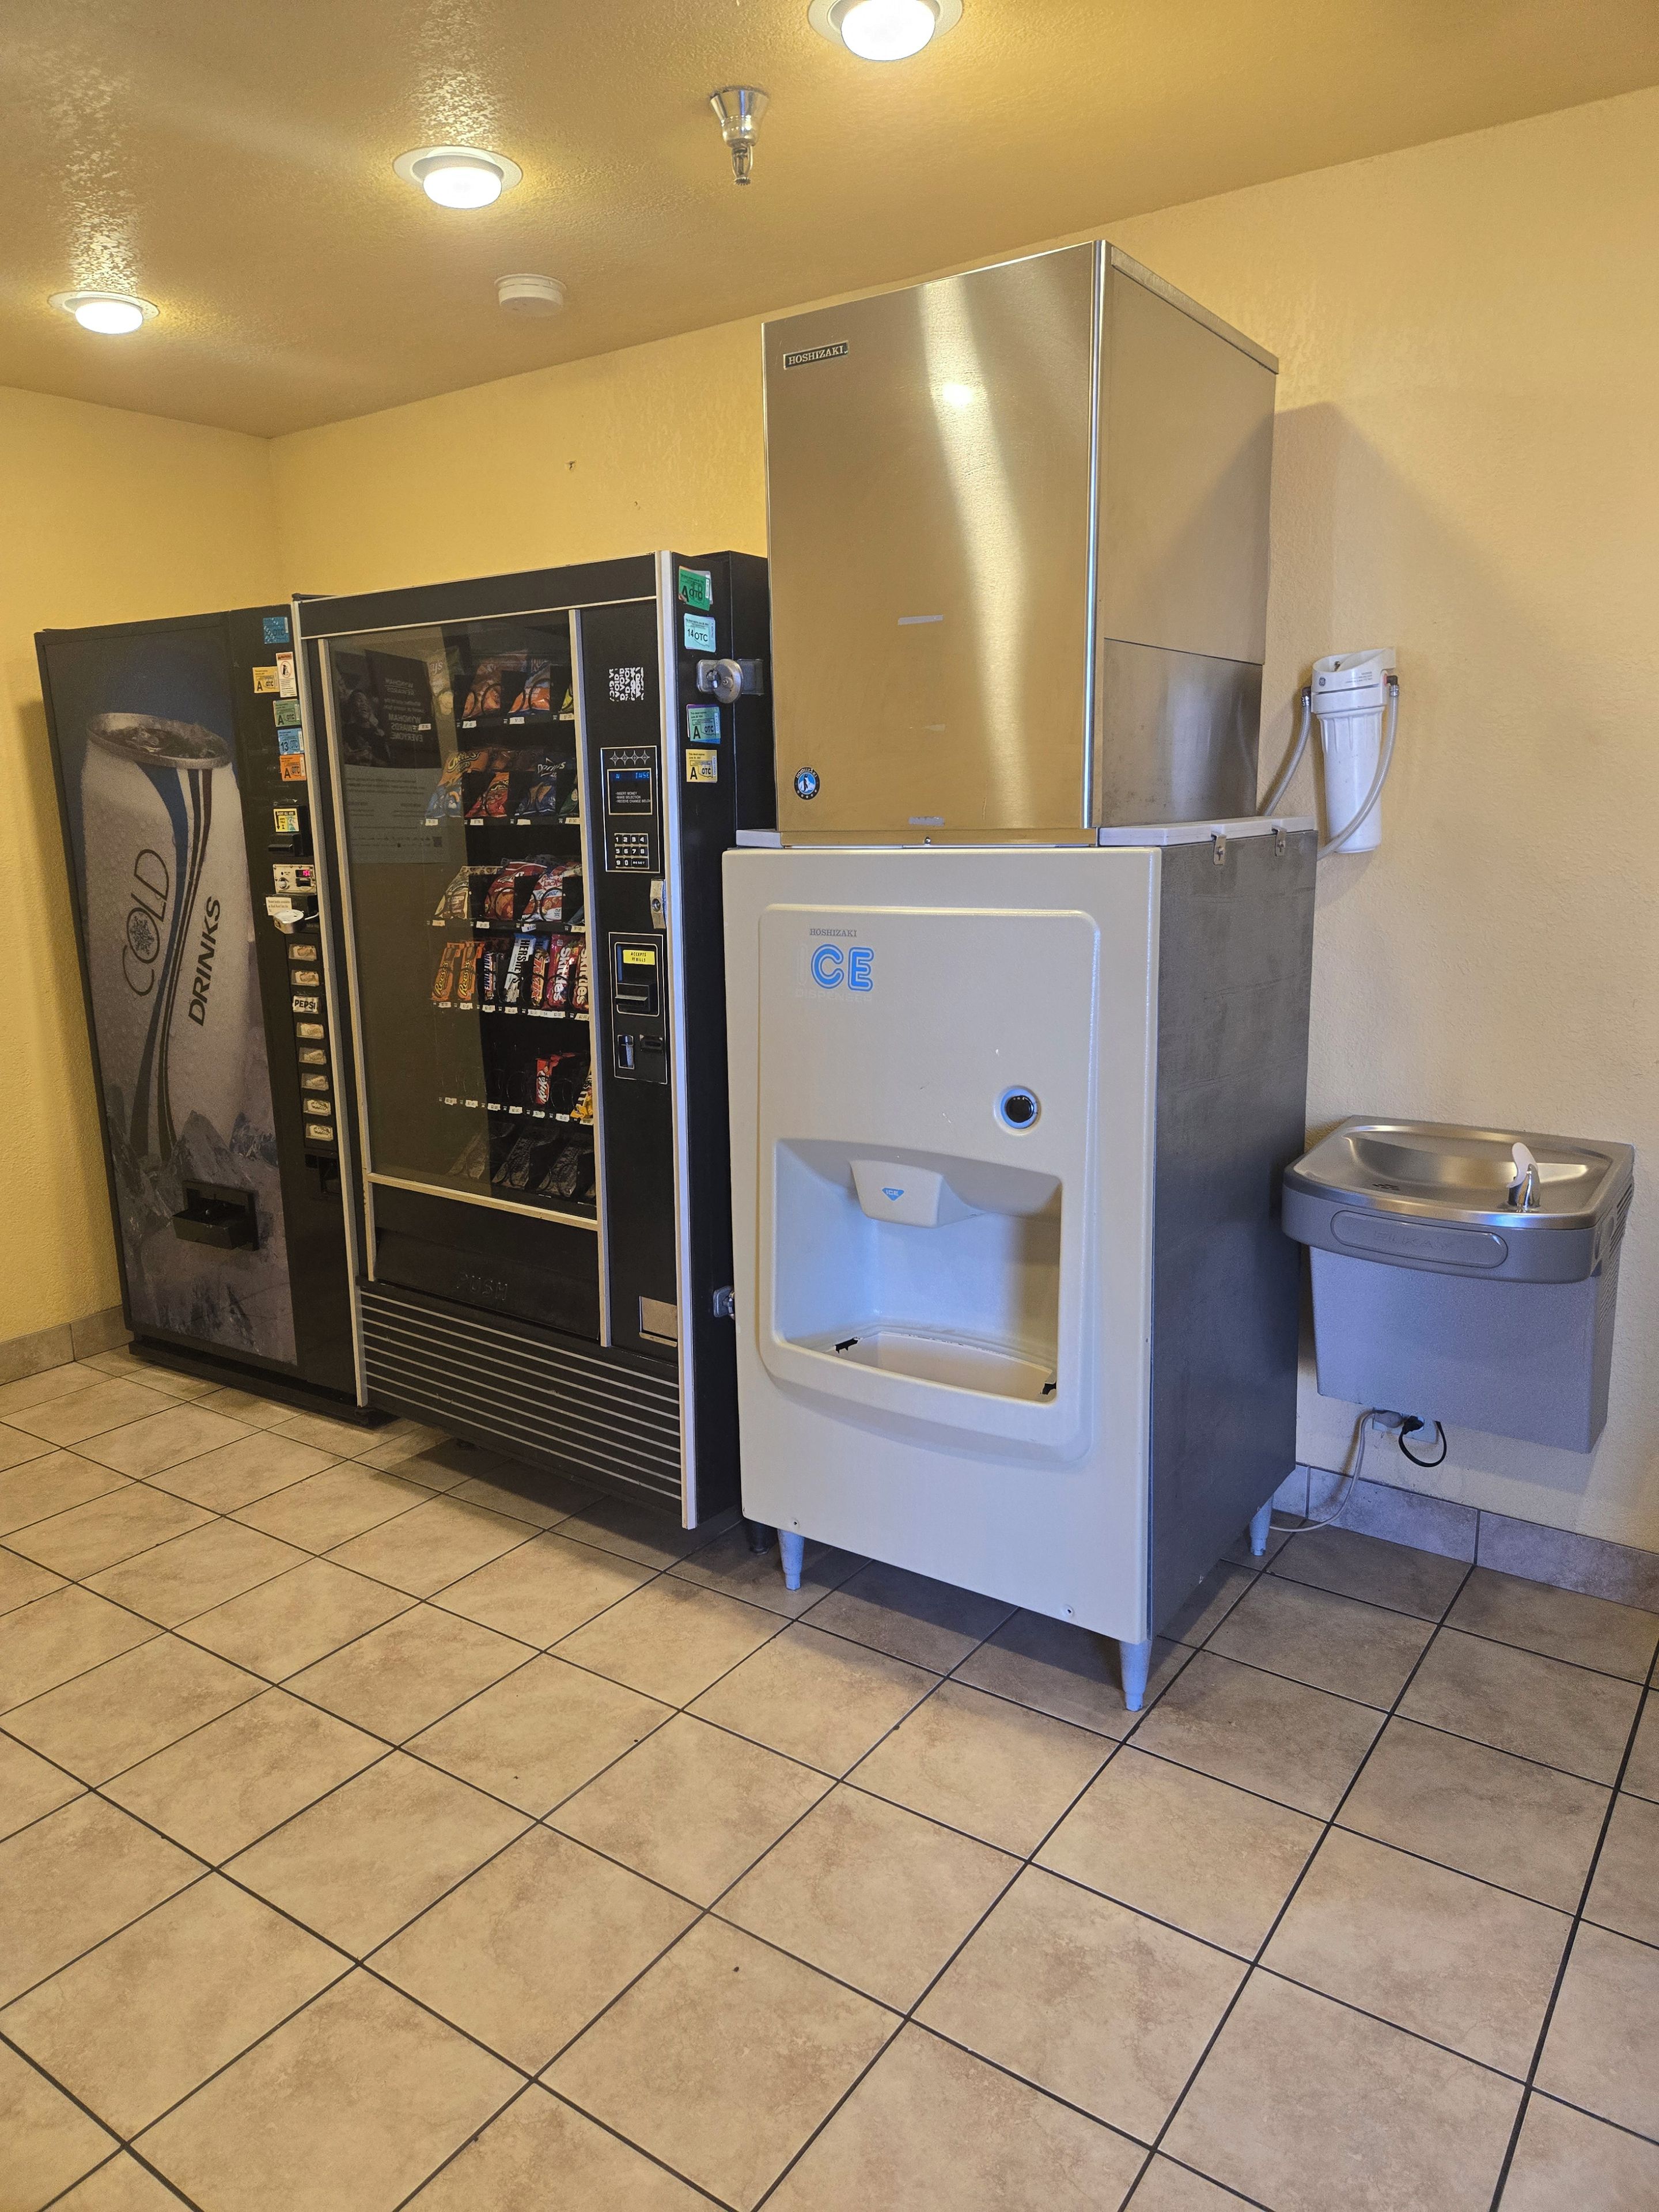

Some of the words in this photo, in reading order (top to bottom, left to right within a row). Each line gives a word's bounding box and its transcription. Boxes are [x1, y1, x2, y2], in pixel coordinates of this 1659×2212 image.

[788, 345, 844, 365] HOSHIZAKI
[682, 585, 689, 603] A
[689, 589, 703, 600] OTC
[688, 628, 694, 637] 14
[694, 632, 708, 642] OTC
[257, 681, 263, 691] A
[278, 714, 284, 725] A
[693, 726, 700, 739] A
[281, 741, 288, 751] 13
[284, 768, 291, 778] A
[690, 767, 698, 780] A
[122, 849, 169, 996] COLD
[809, 929, 857, 937] HOSHIZAKI
[188, 896, 220, 1027] DRINKS
[294, 999, 316, 1010] PEPSI
[1374, 1230, 1455, 1251] ELKAY
[456, 1274, 507, 1301] PUSH
